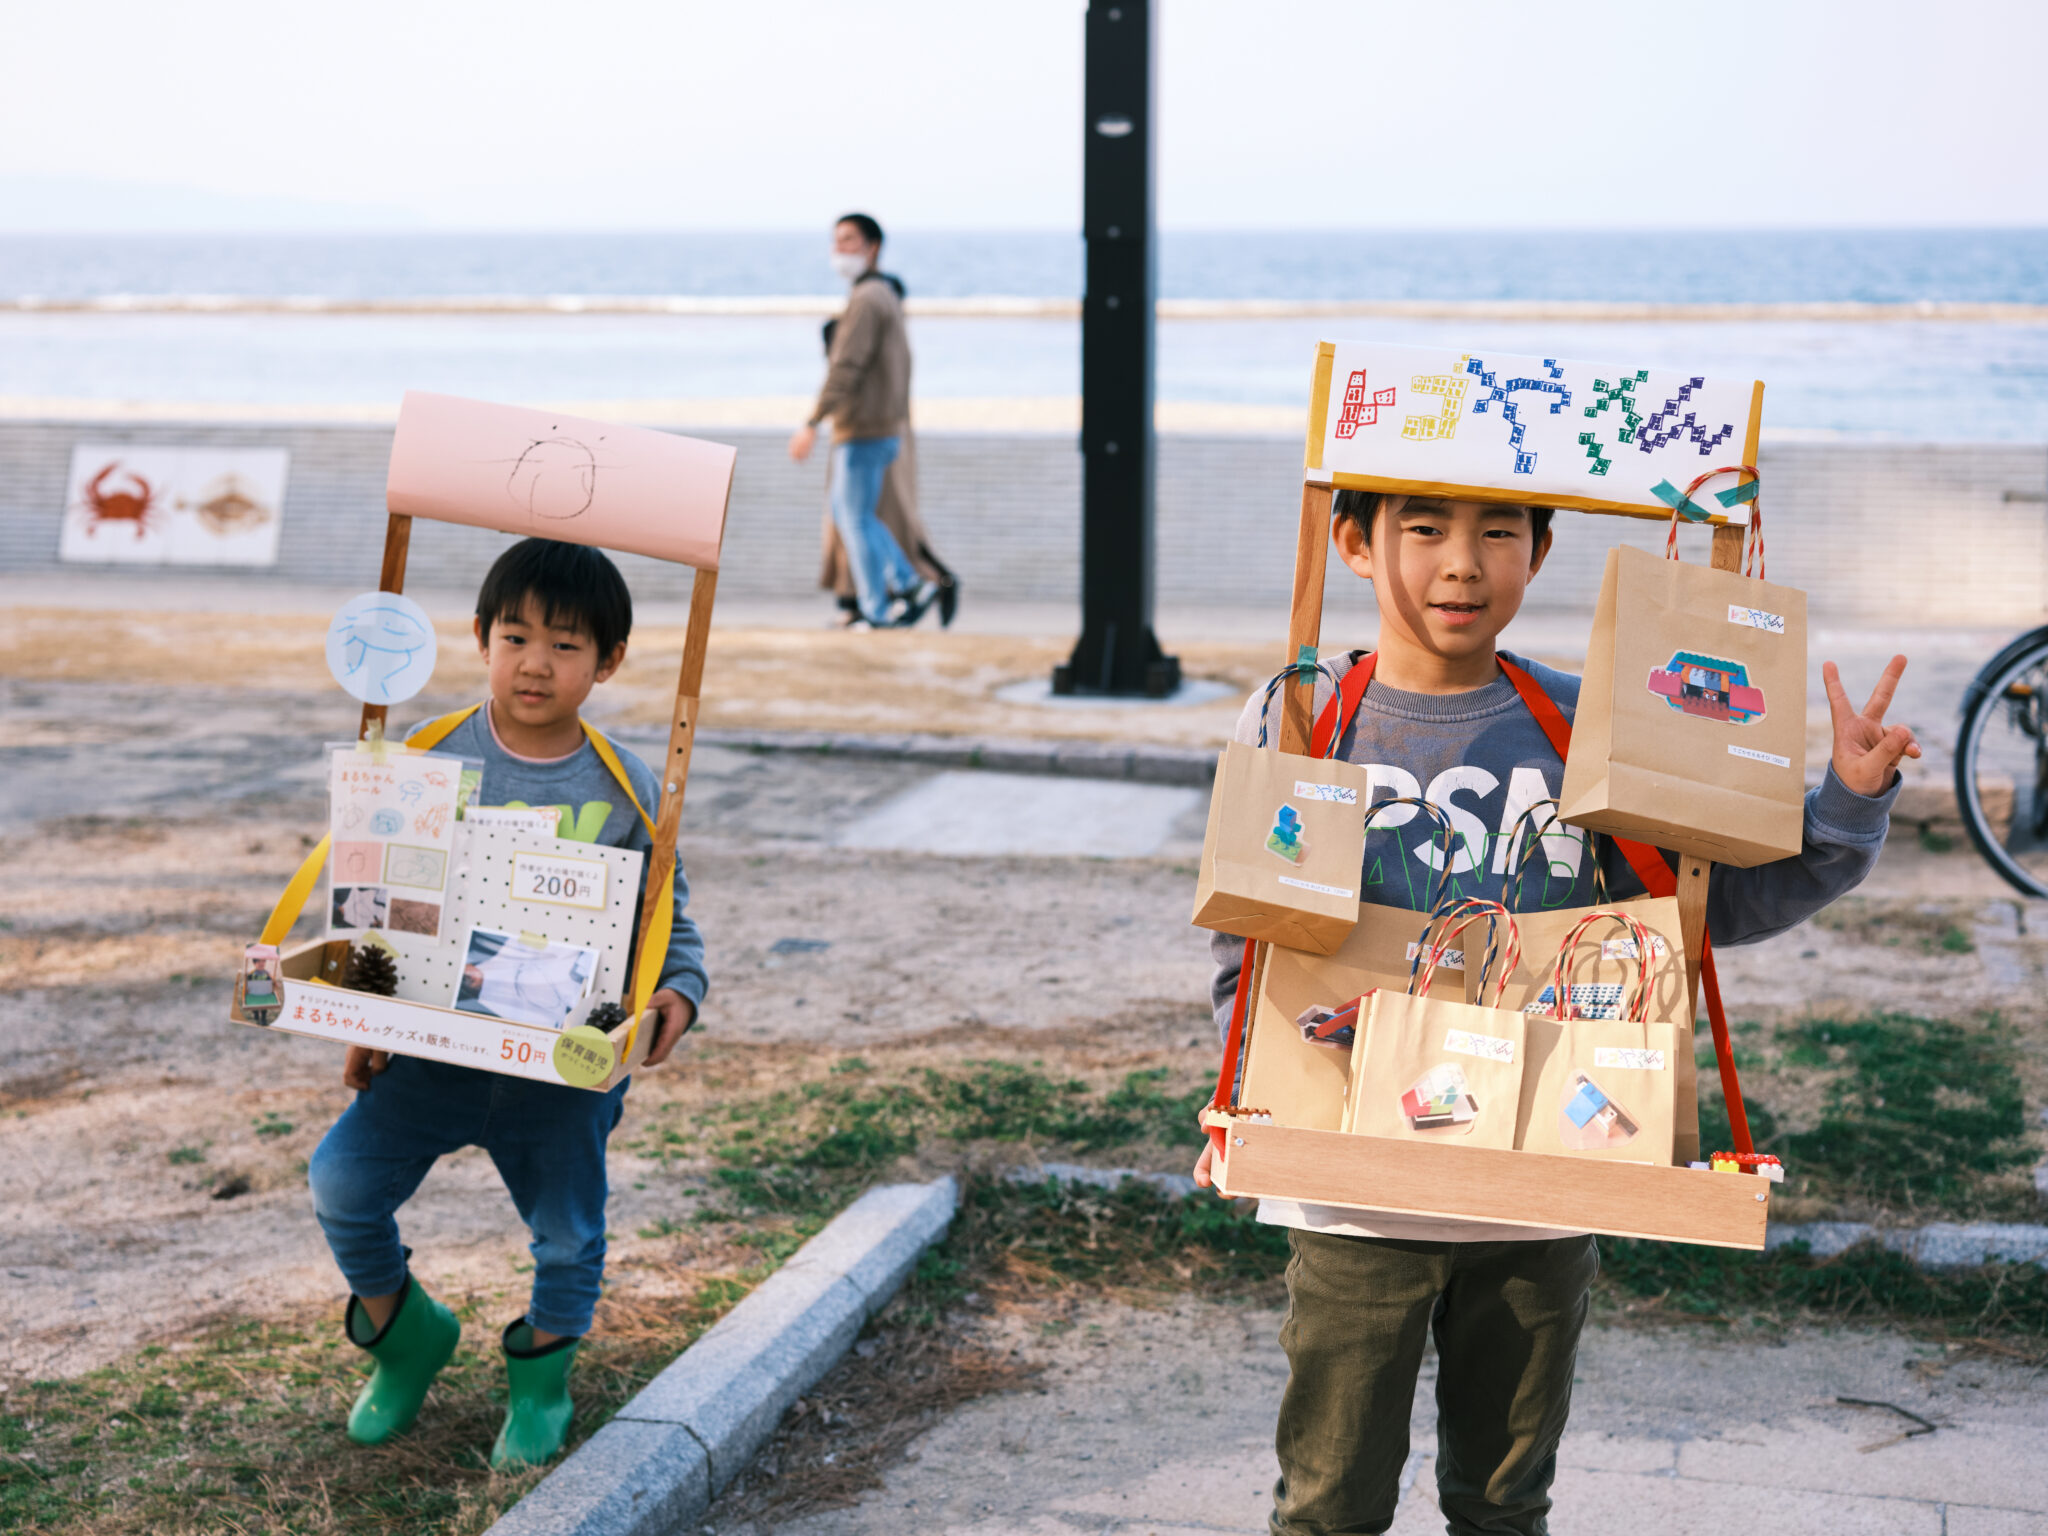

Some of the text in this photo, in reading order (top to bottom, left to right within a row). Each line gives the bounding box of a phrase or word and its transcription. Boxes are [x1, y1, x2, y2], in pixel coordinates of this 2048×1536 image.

[532, 873, 591, 898] 200円
[500, 1038, 547, 1064] 50円
[560, 1036, 609, 1071] 保育園児
